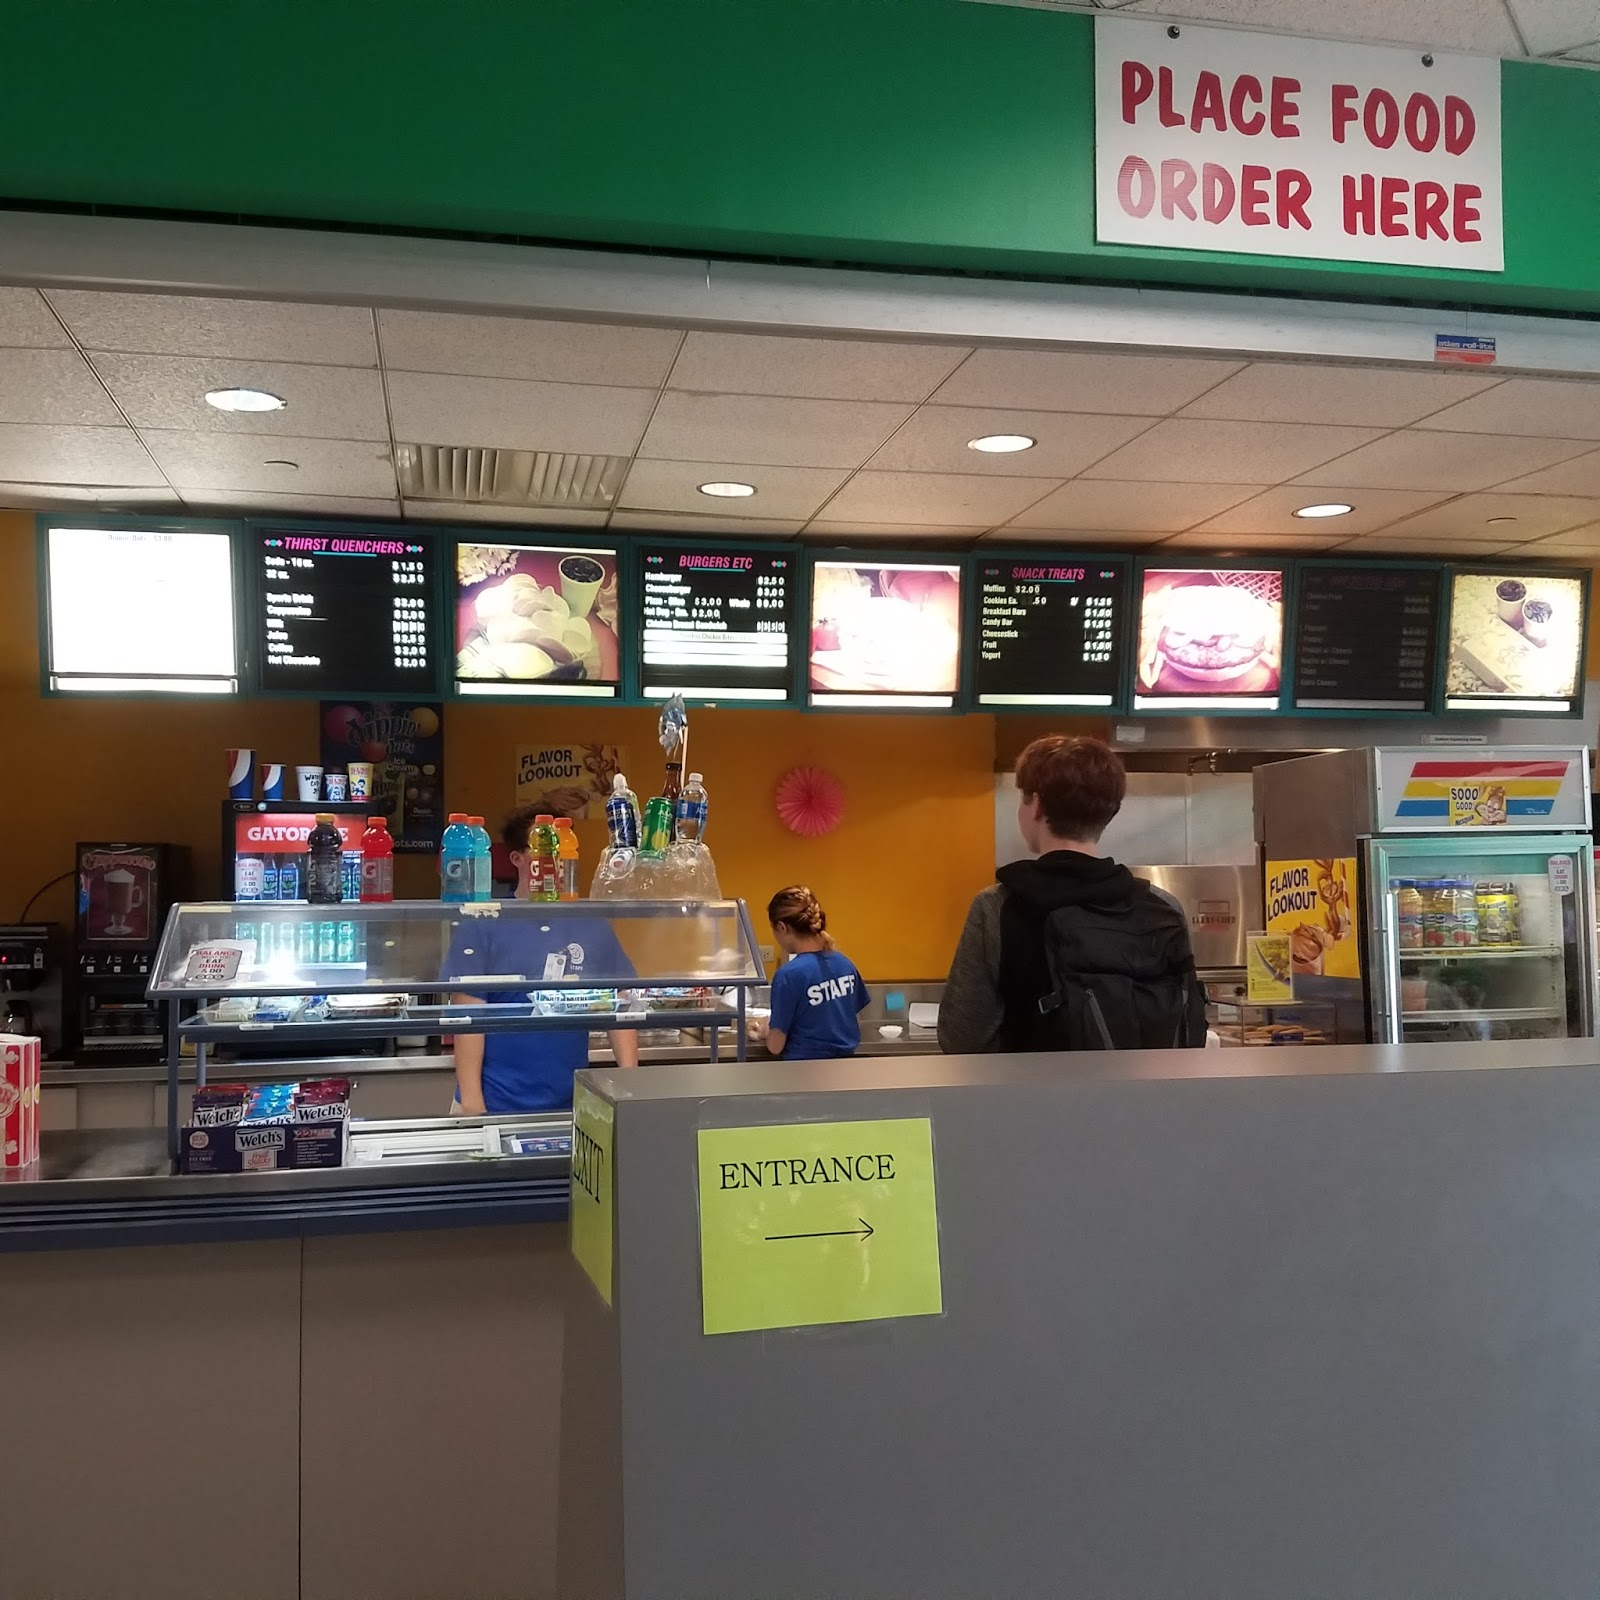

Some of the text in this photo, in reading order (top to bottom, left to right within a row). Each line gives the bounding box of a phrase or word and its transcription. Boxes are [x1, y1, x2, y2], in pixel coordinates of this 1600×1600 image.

[1121, 61, 1476, 156] PLACE FOOD
[1117, 155, 1482, 243] ORDER HERE
[284, 537, 404, 554] THIRST QUENCHERS
[679, 555, 753, 569] BURGERS ETC
[1011, 567, 1085, 580] SNACK TREATS
[983, 584, 1006, 593] Muffins
[983, 597, 1007, 605] Cookies
[983, 607, 1027, 616] Breakfast Bars
[982, 618, 1013, 627] Candy Bar
[983, 641, 997, 649] Fruit
[982, 651, 1001, 660] Yogurt
[393, 757, 406, 765] Ice
[521, 749, 573, 769] FLAVOR
[386, 763, 415, 772] Cream
[518, 764, 582, 785] LOOKOUT
[1451, 788, 1479, 800] SOOO
[247, 826, 349, 842] GATORE
[394, 838, 434, 848] ots.com
[1270, 867, 1309, 898] FLAVOR
[1267, 890, 1317, 922] LOOKOUT
[807, 974, 856, 1007] STAFF
[195, 1108, 240, 1127] Welch's
[298, 1104, 344, 1122] Welch's
[239, 1131, 283, 1148] Welch's
[573, 1123, 604, 1204] EXIT
[720, 1154, 896, 1190] ENTRANCE
